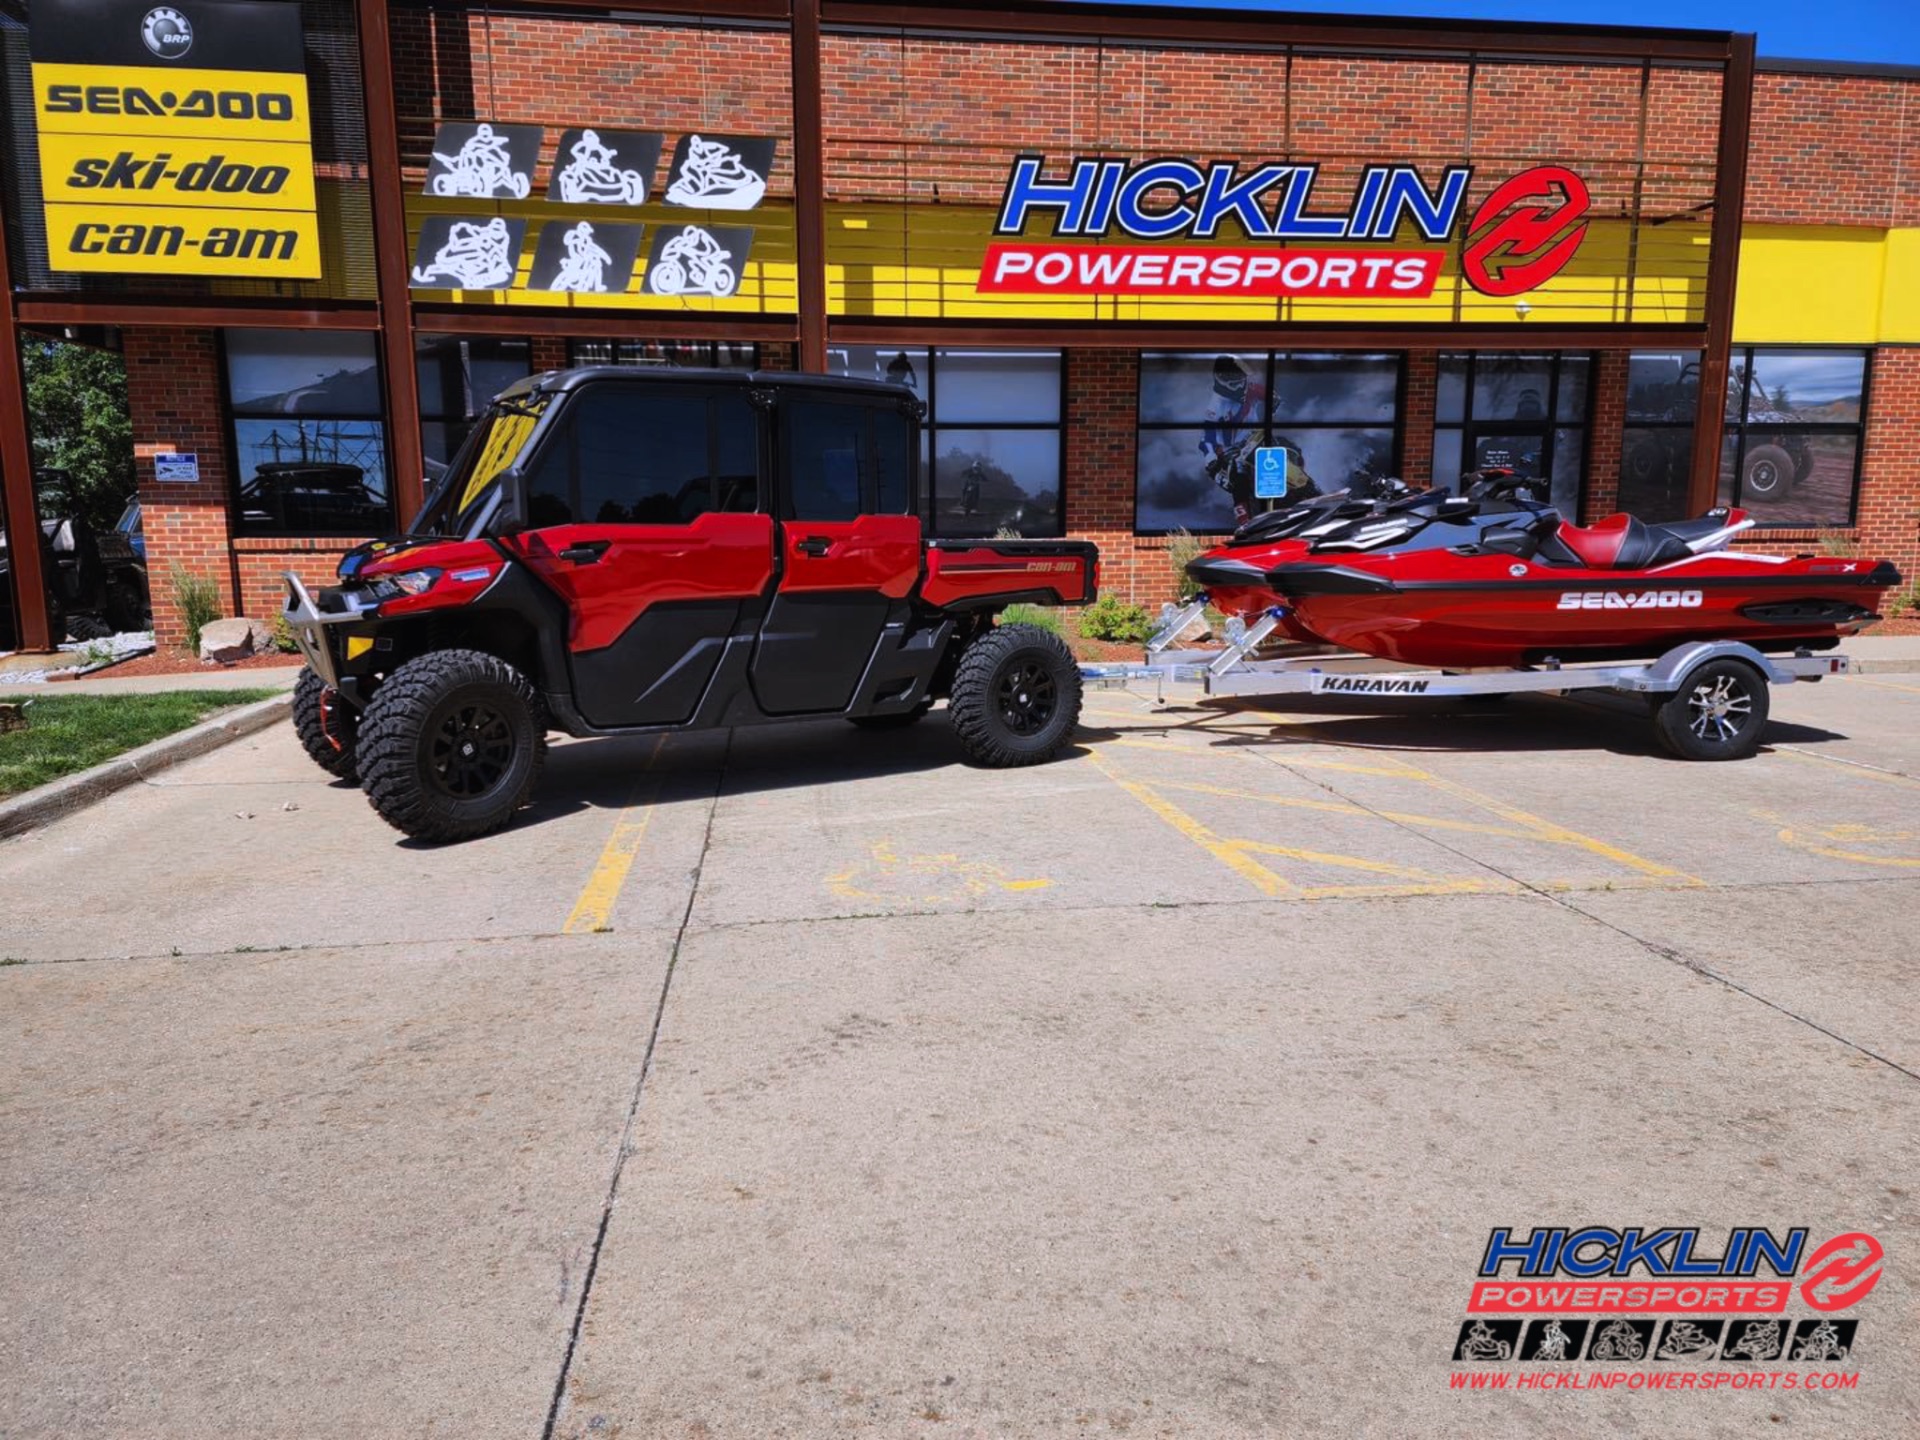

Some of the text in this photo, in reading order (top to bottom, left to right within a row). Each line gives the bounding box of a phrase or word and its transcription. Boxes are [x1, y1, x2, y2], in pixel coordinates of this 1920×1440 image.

[162, 33, 191, 43] BRP
[65, 152, 290, 194] ski-doo
[993, 154, 1474, 242] HICKLIN
[68, 223, 298, 260] can-am
[993, 252, 1428, 289] POWERSPORTS
[1321, 677, 1430, 693] KARAVAN
